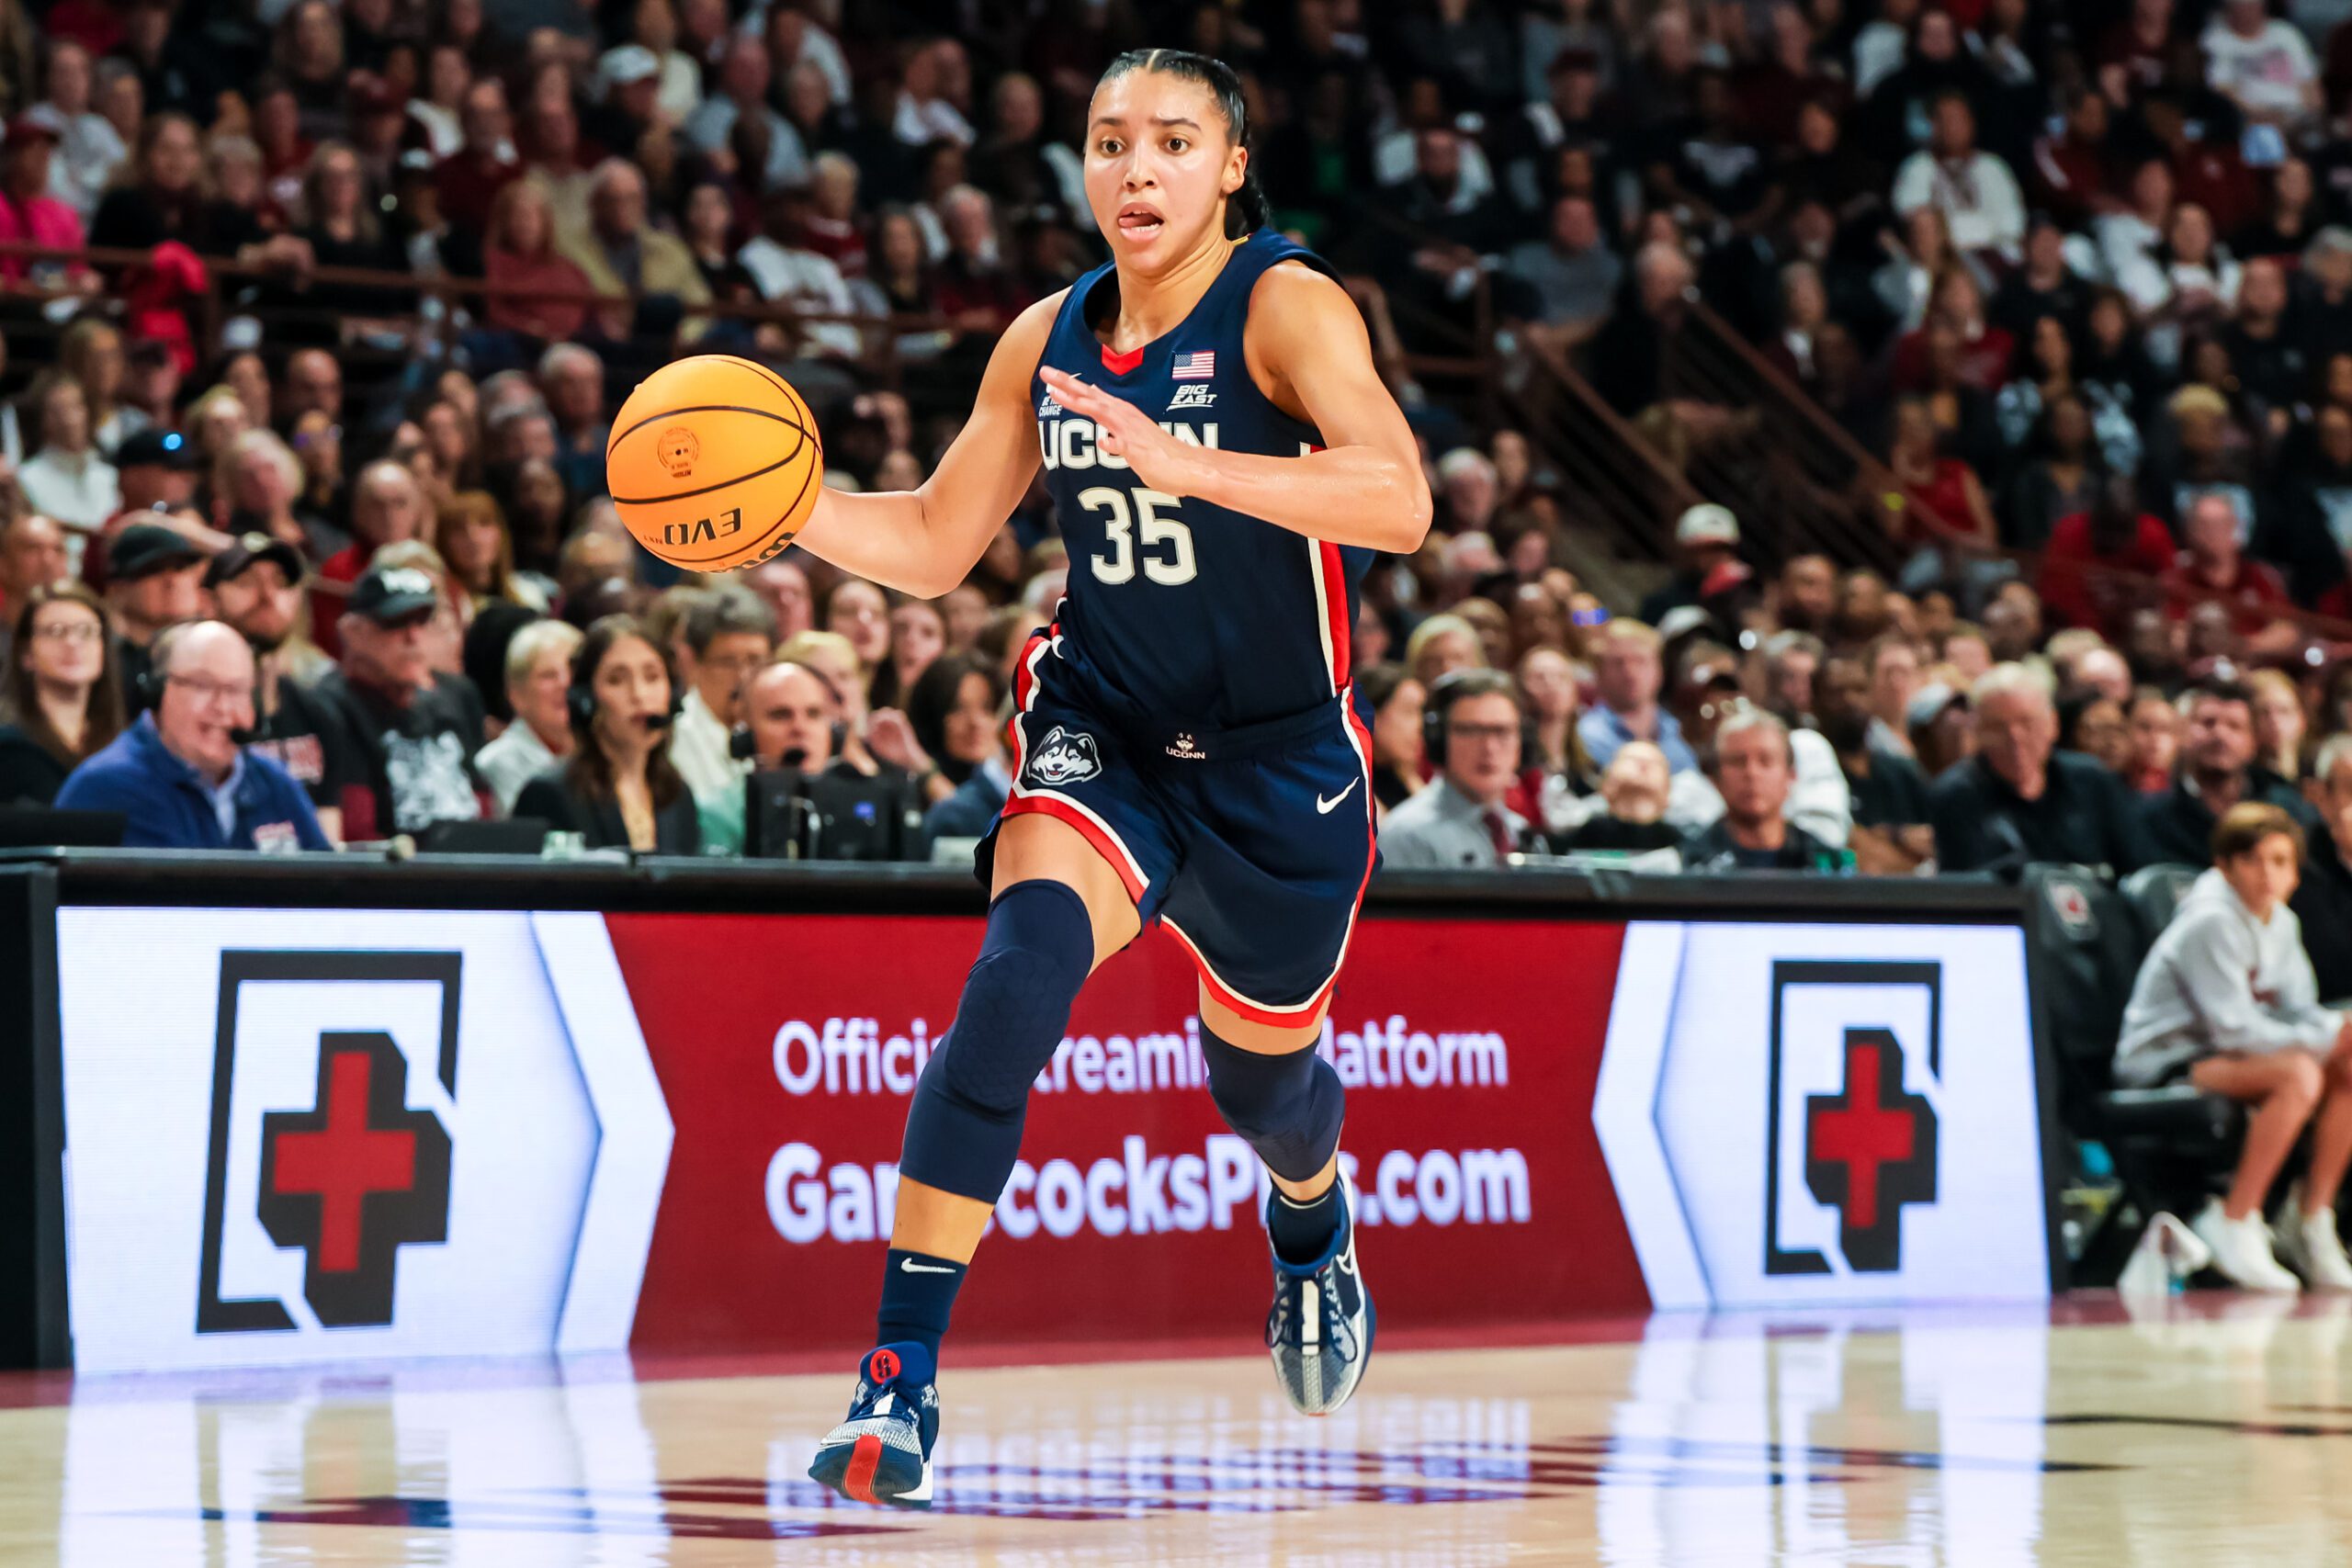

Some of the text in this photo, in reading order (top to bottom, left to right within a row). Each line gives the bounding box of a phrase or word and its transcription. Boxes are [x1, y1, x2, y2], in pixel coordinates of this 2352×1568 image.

[1176, 384, 1210, 395] BIG
[1170, 394, 1217, 405] EAST
[1038, 404, 1063, 417] CHANGE
[664, 507, 742, 546] EVO
[1077, 486, 1197, 586] 35
[1166, 746, 1205, 760] UCONN
[773, 1017, 944, 1096] Offici
[1315, 1014, 1509, 1089] latform
